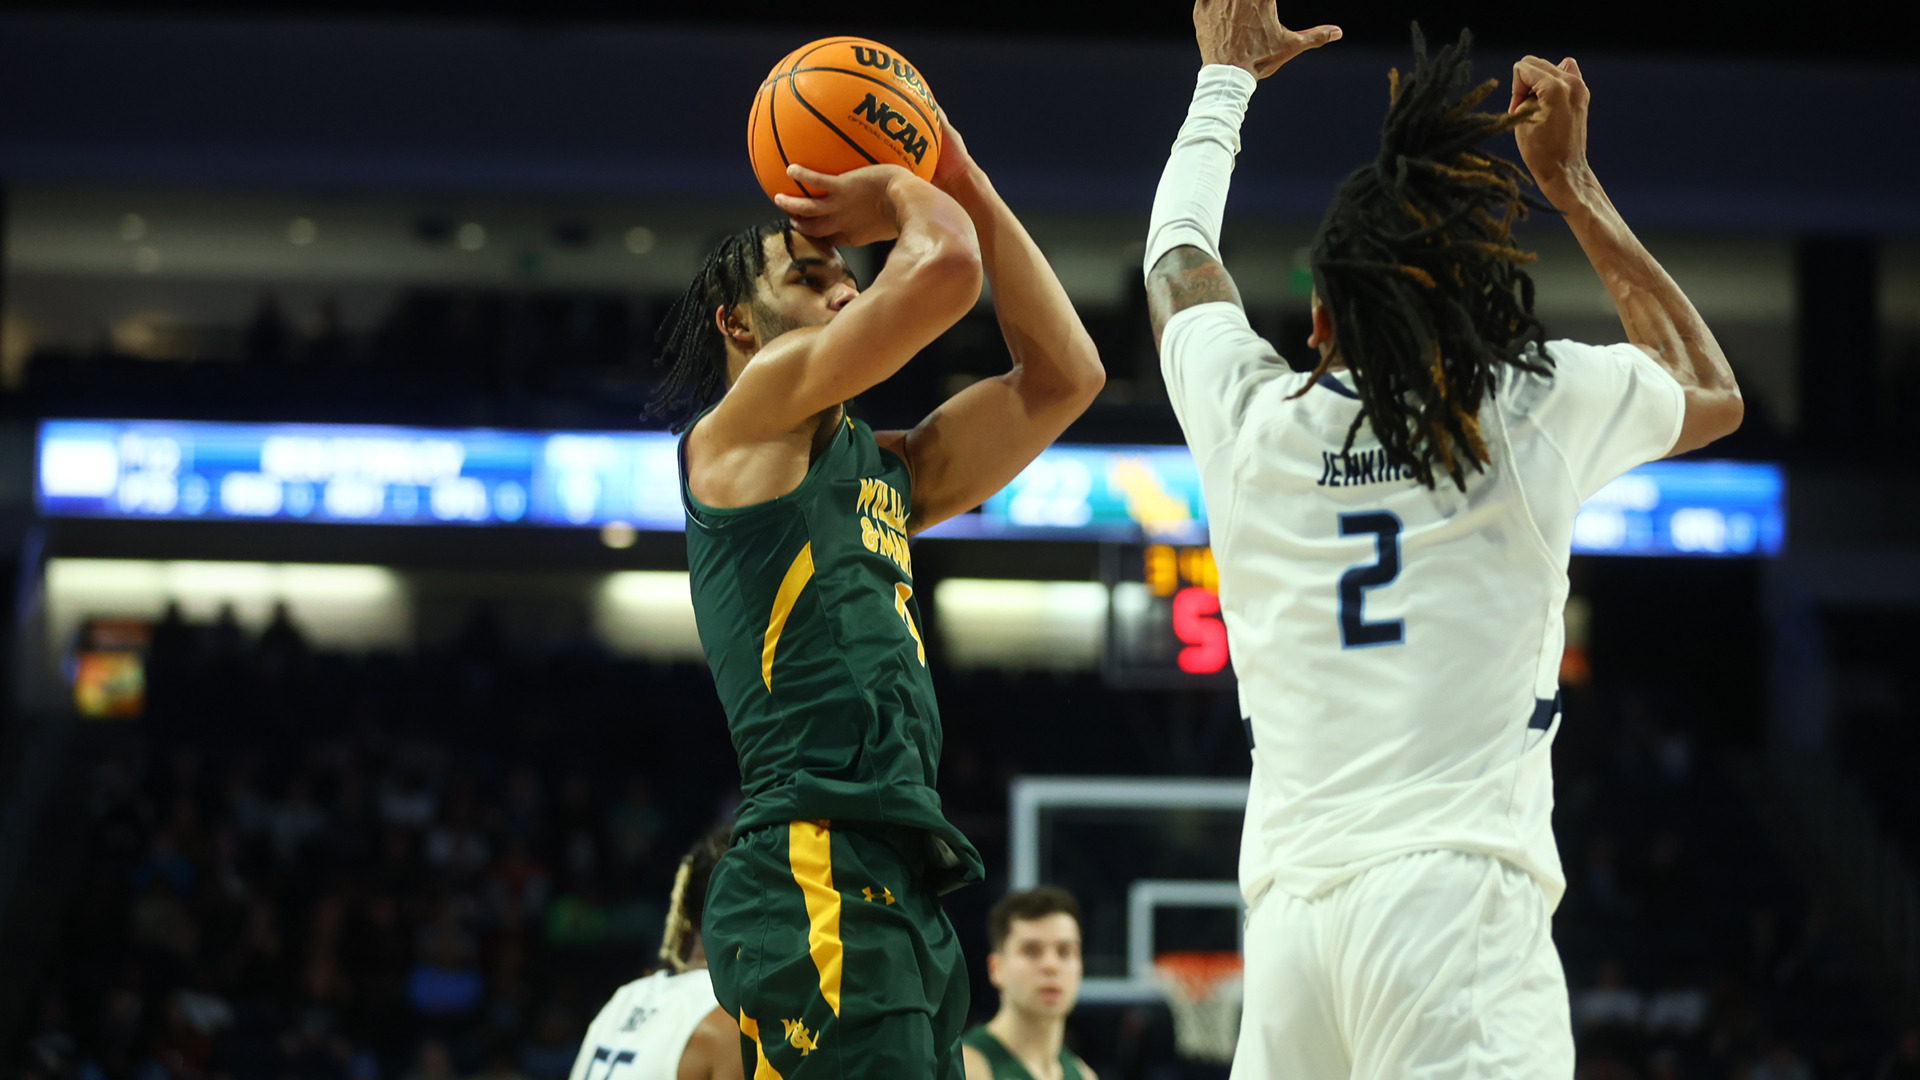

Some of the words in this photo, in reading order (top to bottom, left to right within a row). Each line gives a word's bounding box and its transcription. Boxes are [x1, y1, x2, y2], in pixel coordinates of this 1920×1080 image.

[852, 92, 929, 166] NCAA
[856, 477, 911, 541] WILLI
[1337, 509, 1406, 651] 2
[1172, 587, 1229, 674] 5
